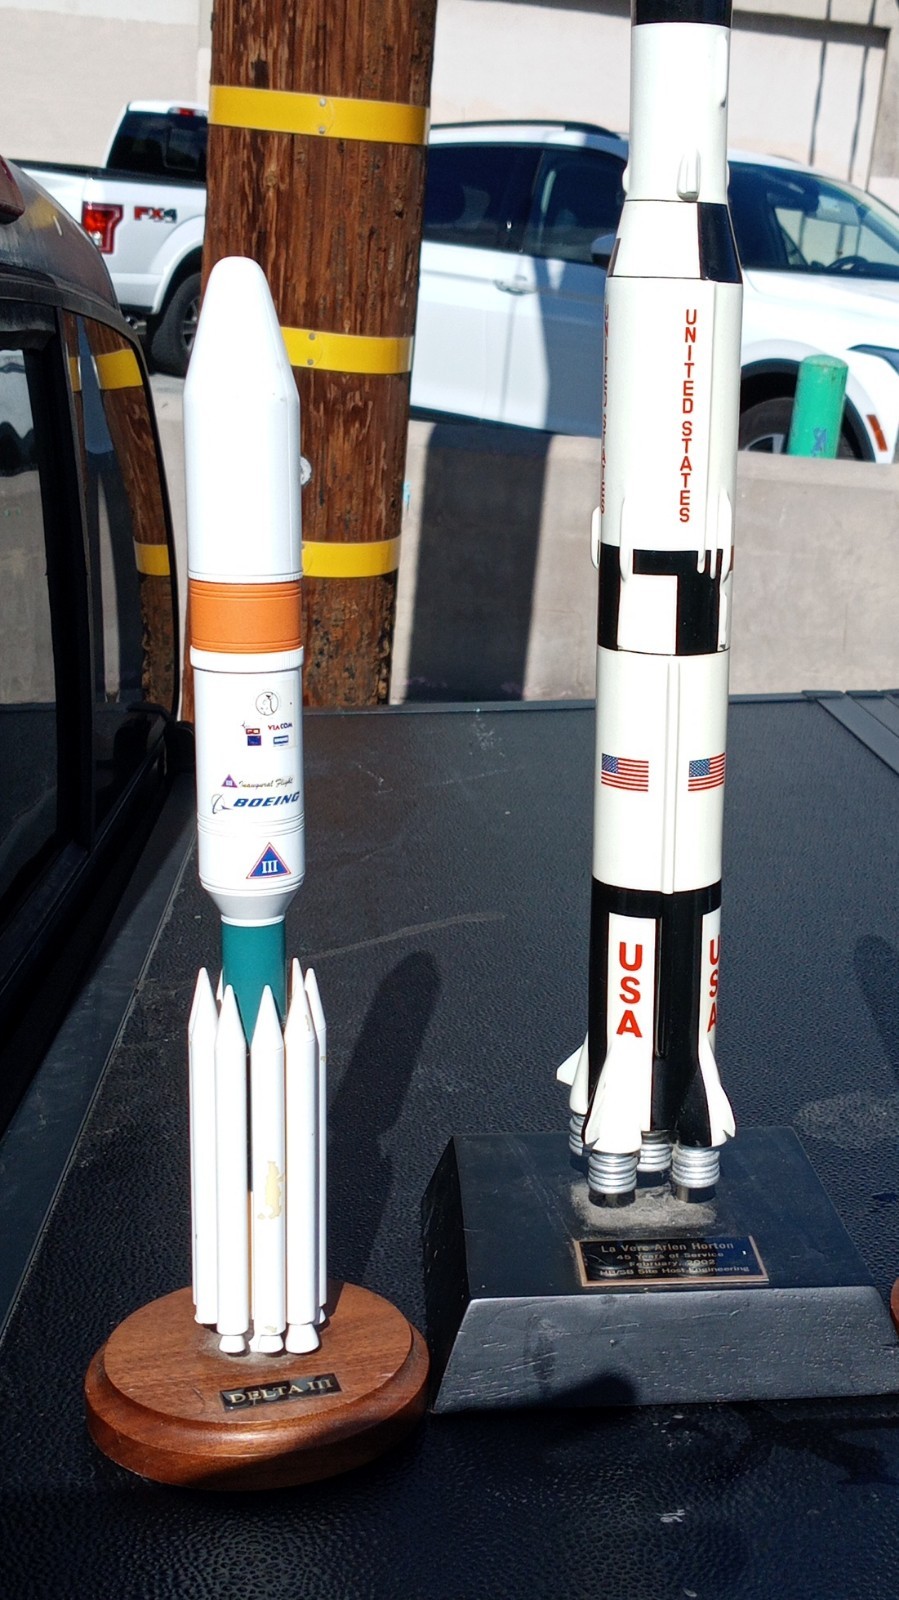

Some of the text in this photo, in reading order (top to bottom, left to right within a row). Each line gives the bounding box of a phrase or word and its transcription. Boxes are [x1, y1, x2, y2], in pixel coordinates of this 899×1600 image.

[133, 206, 177, 223] FX4
[679, 309, 697, 523] UNITED STATES
[267, 722, 293, 731] VIACOM
[238, 780, 274, 790] Inaugural
[233, 791, 300, 807] BOEING
[261, 859, 278, 874] III
[616, 941, 643, 1038] USA
[707, 934, 721, 1033] USA
[601, 1245, 616, 1253] La
[655, 1243, 687, 1252] Arlen
[691, 1242, 734, 1250] Horton
[686, 1259, 715, 1267] 2002
[229, 1378, 334, 1404] DELTA III
